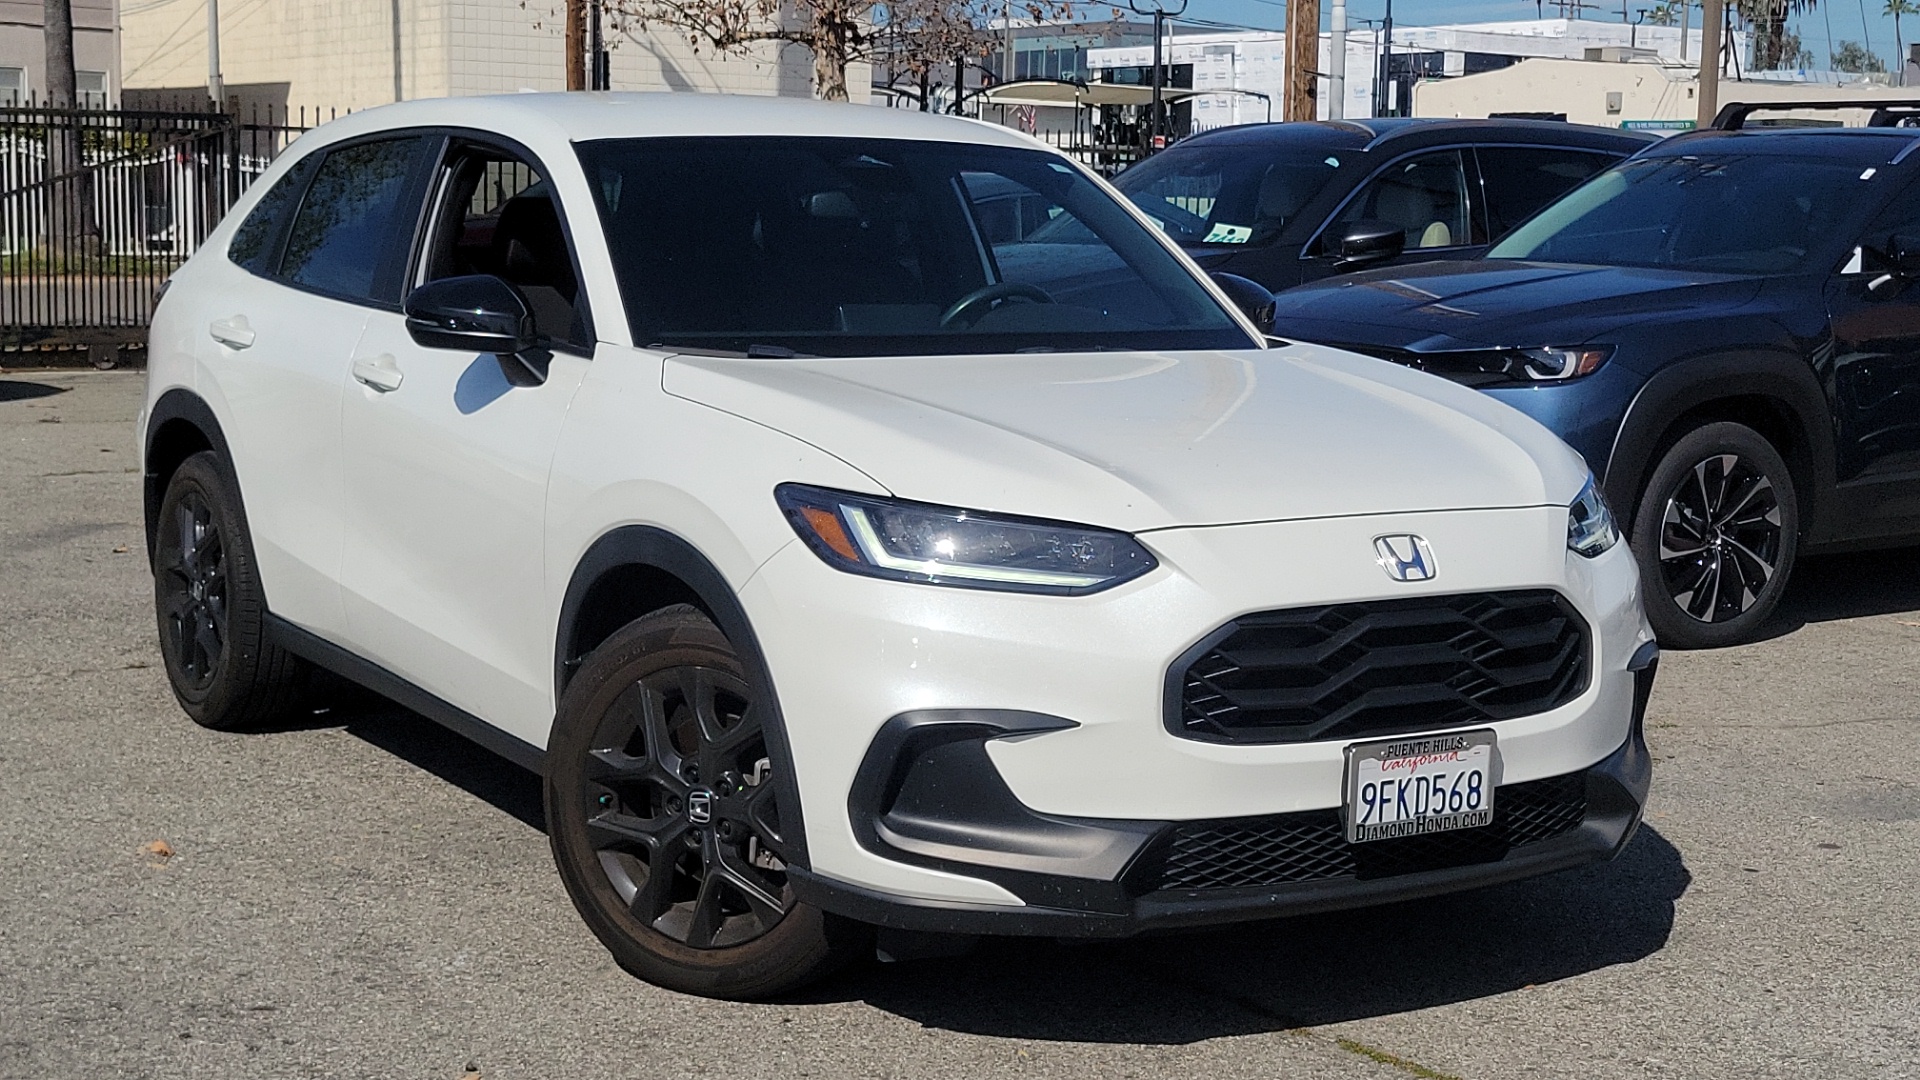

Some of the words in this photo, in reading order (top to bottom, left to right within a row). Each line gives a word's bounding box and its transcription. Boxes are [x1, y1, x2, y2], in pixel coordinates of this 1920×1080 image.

[1386, 740, 1429, 758] PUENTE
[1433, 736, 1464, 752] HILLS
[1361, 769, 1483, 824] 9FKD568
